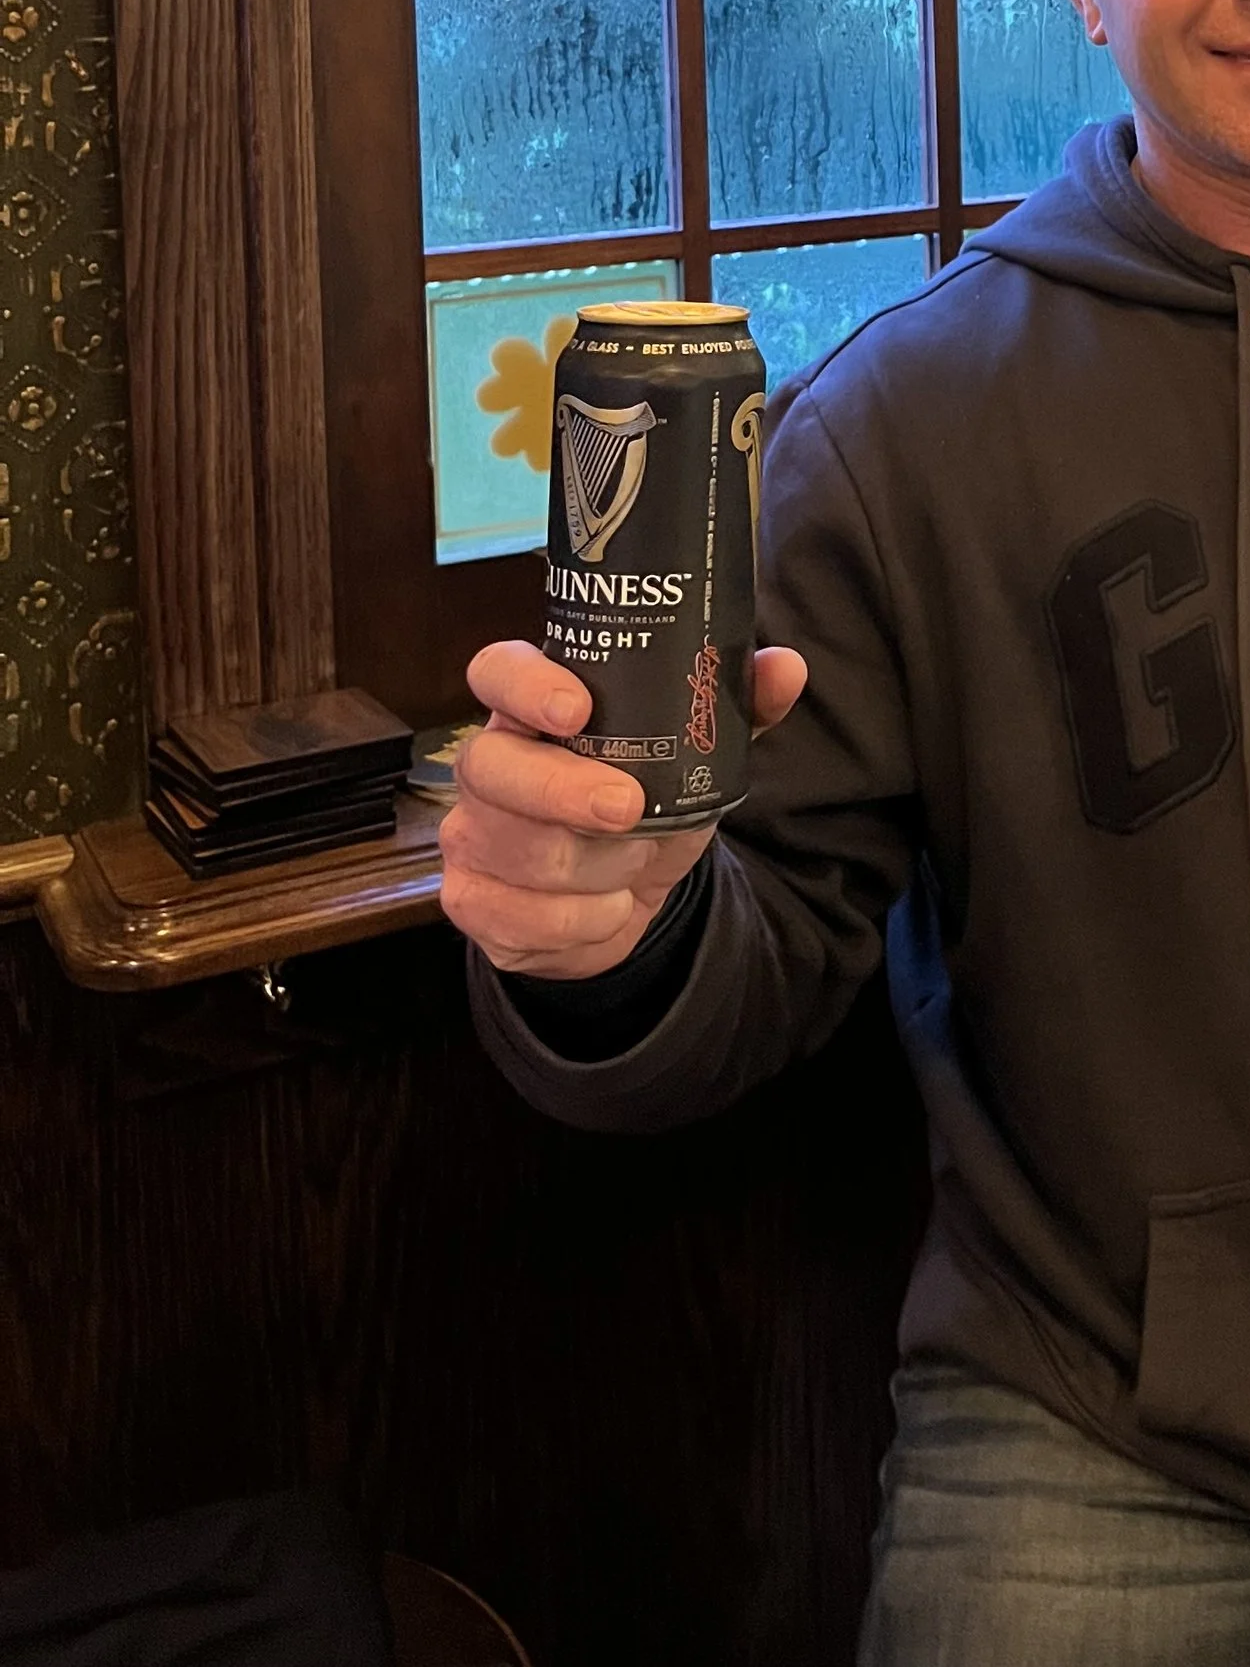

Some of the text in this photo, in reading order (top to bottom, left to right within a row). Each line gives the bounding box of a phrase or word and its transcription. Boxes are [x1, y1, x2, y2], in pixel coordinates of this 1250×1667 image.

[587, 341, 619, 353] GLASS
[642, 343, 675, 355] BEST
[681, 341, 732, 355] ENJOYED
[545, 565, 685, 606] UINNESS
[629, 615, 676, 624] IRELAND
[546, 620, 652, 648] DRAUGHT
[564, 646, 610, 663] STOUT
